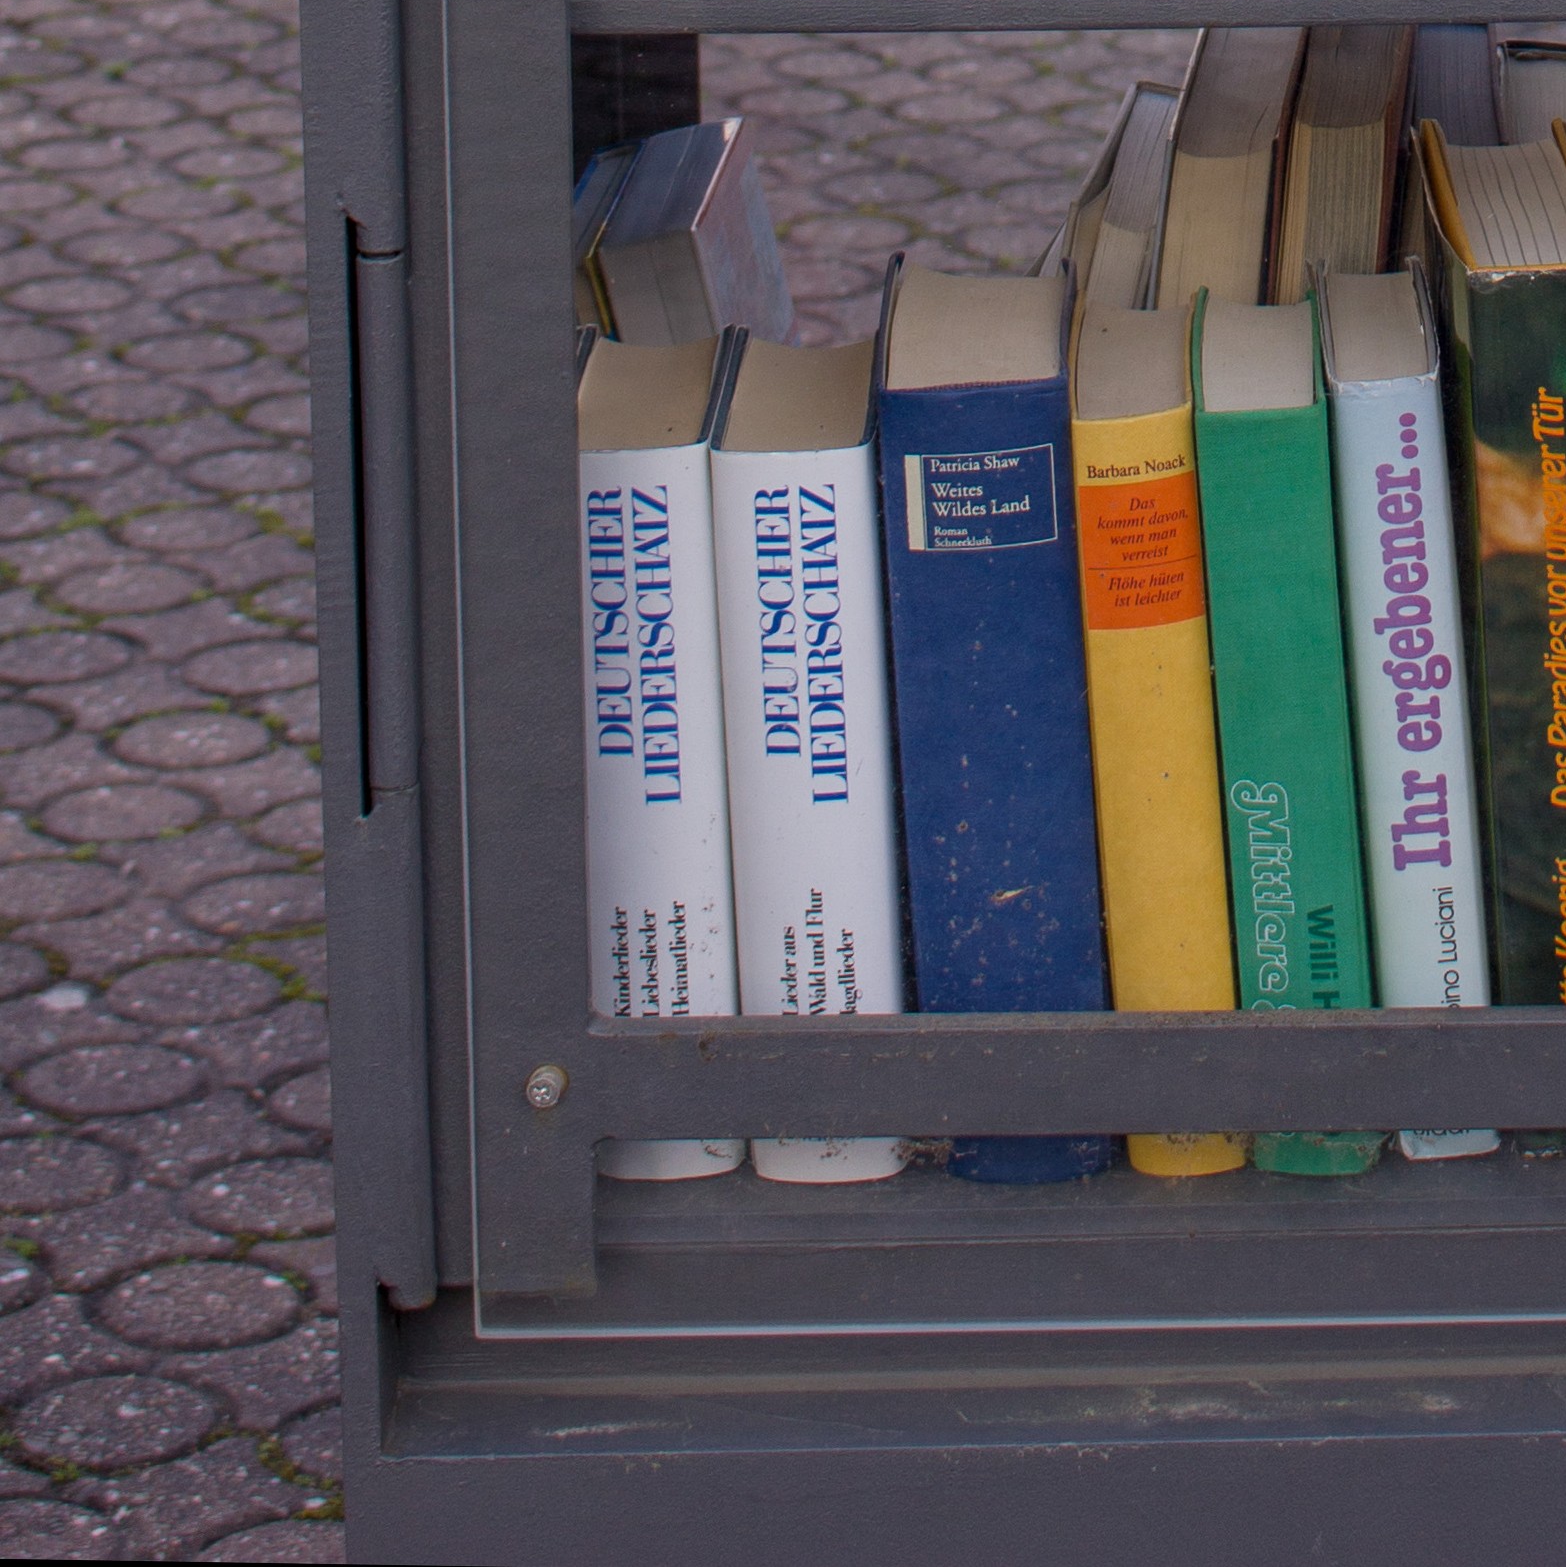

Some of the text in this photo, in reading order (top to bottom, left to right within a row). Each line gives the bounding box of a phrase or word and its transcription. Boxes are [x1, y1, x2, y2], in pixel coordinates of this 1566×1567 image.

[930, 455, 1020, 474] Patricia Shaw
[932, 482, 983, 499] Weites
[933, 496, 1030, 518] Wildes Land
[1086, 454, 1186, 479] Barbara Noack
[587, 485, 635, 758] DEUTSCHER
[631, 484, 682, 805] LIEDERSCHATZ
[754, 484, 802, 757] DEUTSCHER
[799, 484, 849, 805] LIEDERSCHATZ
[1390, 770, 1452, 871] Ihr
[1432, 886, 1459, 964] Luciani
